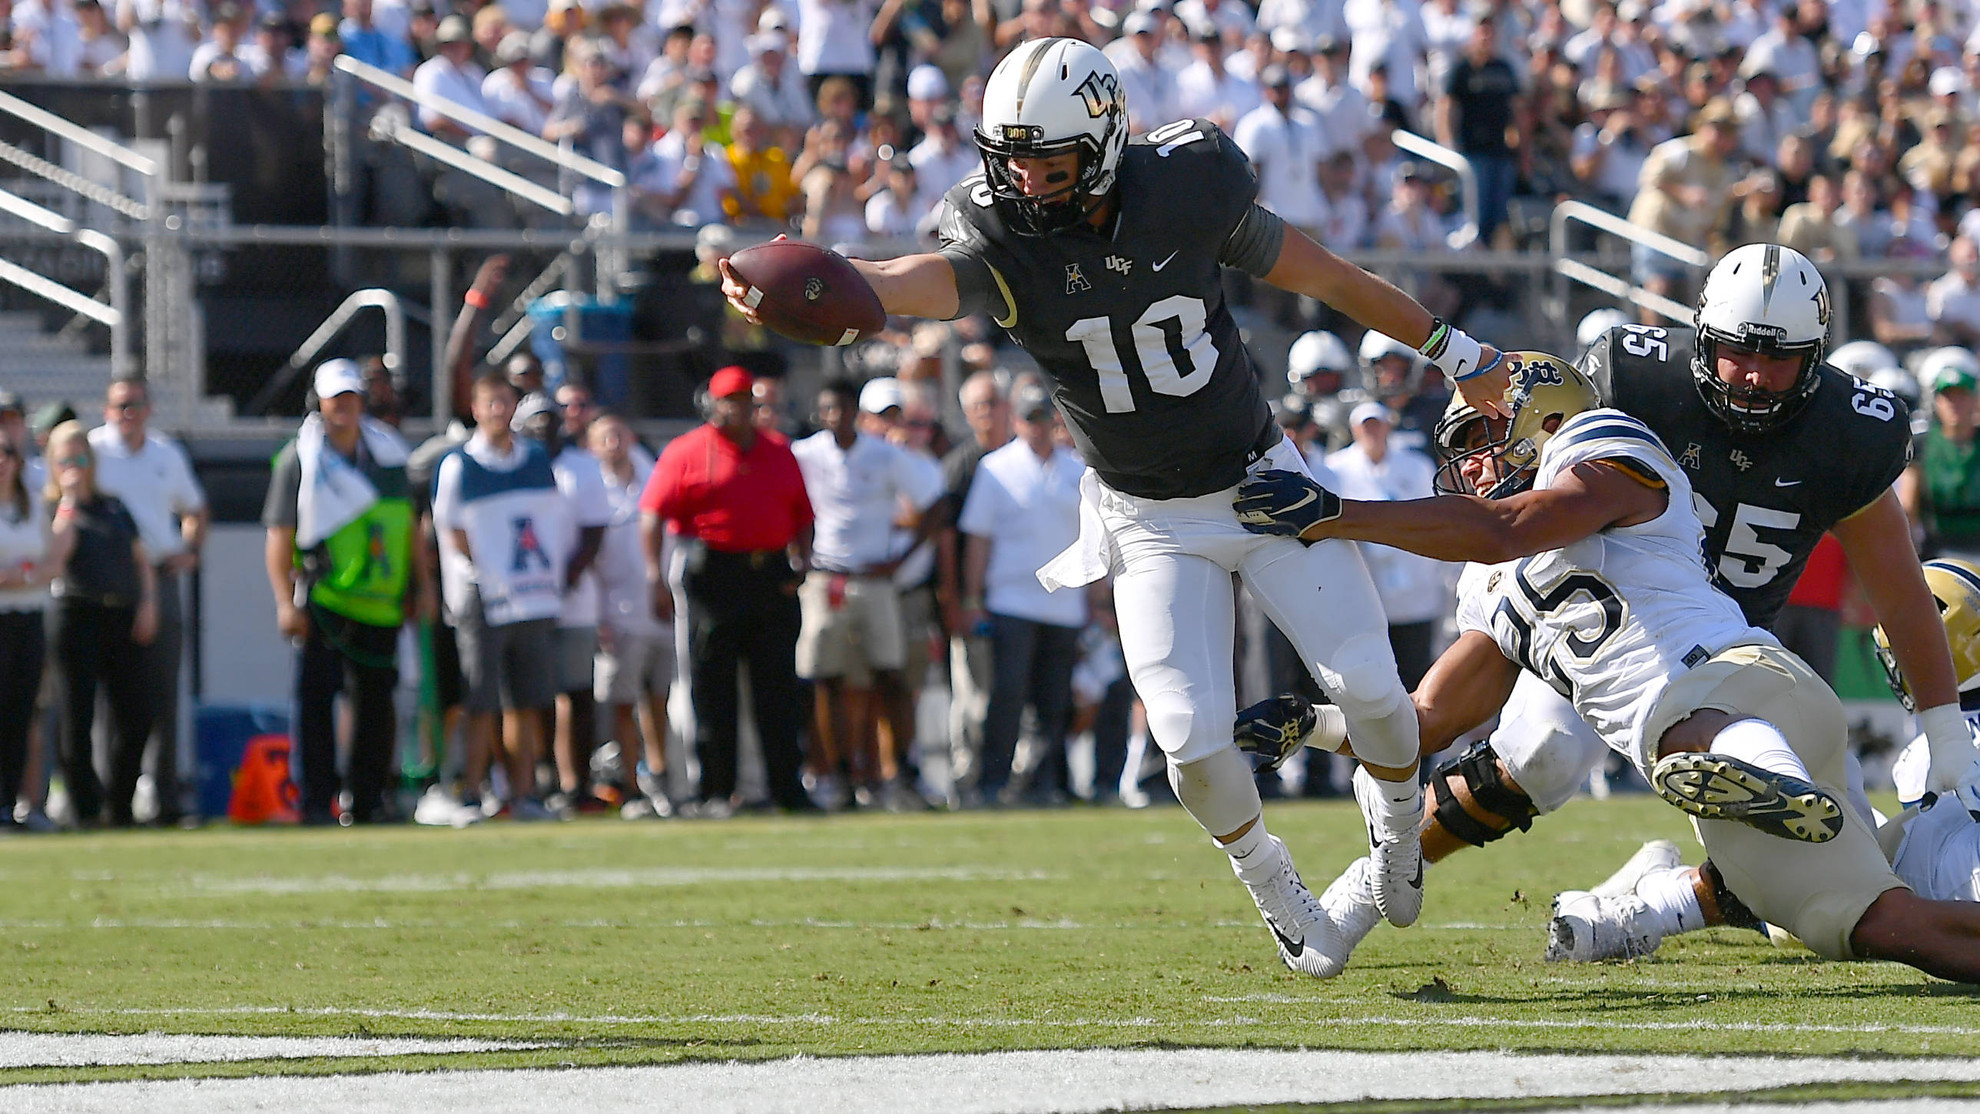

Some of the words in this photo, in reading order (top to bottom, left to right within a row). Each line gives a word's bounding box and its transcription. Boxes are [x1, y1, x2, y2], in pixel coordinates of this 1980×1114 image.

[1146, 118, 1205, 158] 10
[1065, 262, 1092, 294] A
[1104, 254, 1133, 276] UCF
[1621, 323, 1668, 363] 65
[1748, 324, 1776, 337] Riddell
[1065, 294, 1220, 414] 10
[1729, 448, 1754, 471] UCF
[1692, 491, 1801, 589] 5
